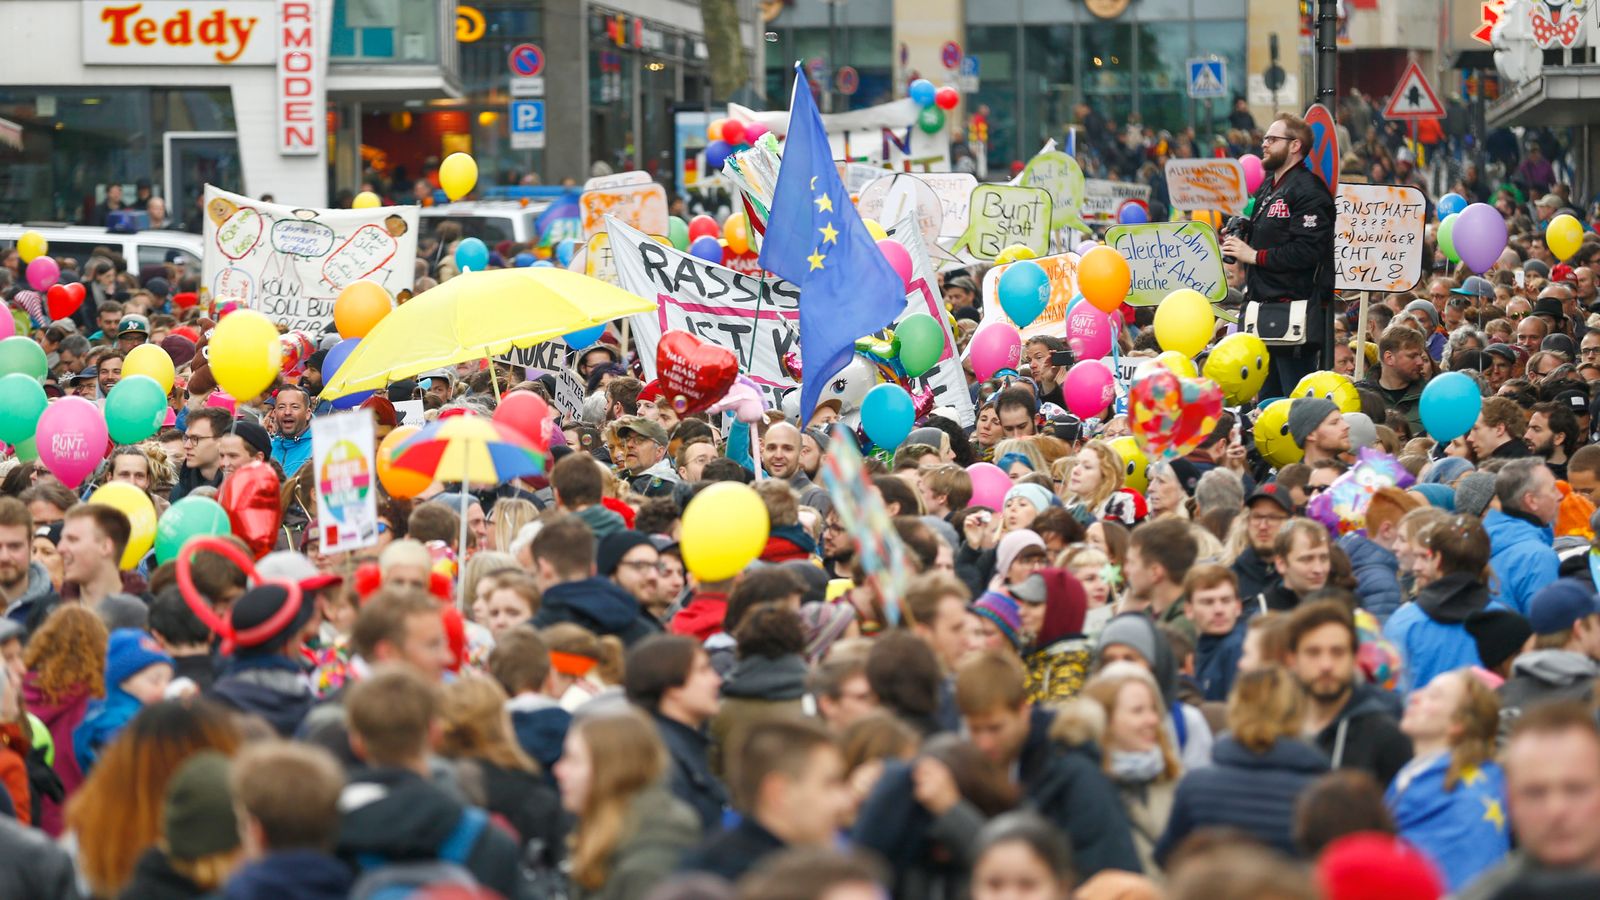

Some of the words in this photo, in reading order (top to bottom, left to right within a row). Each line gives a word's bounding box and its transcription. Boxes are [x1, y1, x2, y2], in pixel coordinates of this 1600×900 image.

[101, 3, 258, 64] Teddy
[982, 191, 1045, 223] Bunt
[1336, 195, 1422, 220] ERNSTHAFT
[1115, 230, 1182, 260] Gleicher
[1172, 223, 1209, 262] Lohn
[1334, 245, 1376, 261] ECHT
[1381, 251, 1408, 262] AUF
[261, 276, 300, 298] KÖLN
[639, 242, 801, 309] RASSIS
[1167, 260, 1217, 299] Arbeit
[263, 295, 301, 316] SOLL
[307, 297, 335, 318] BU
